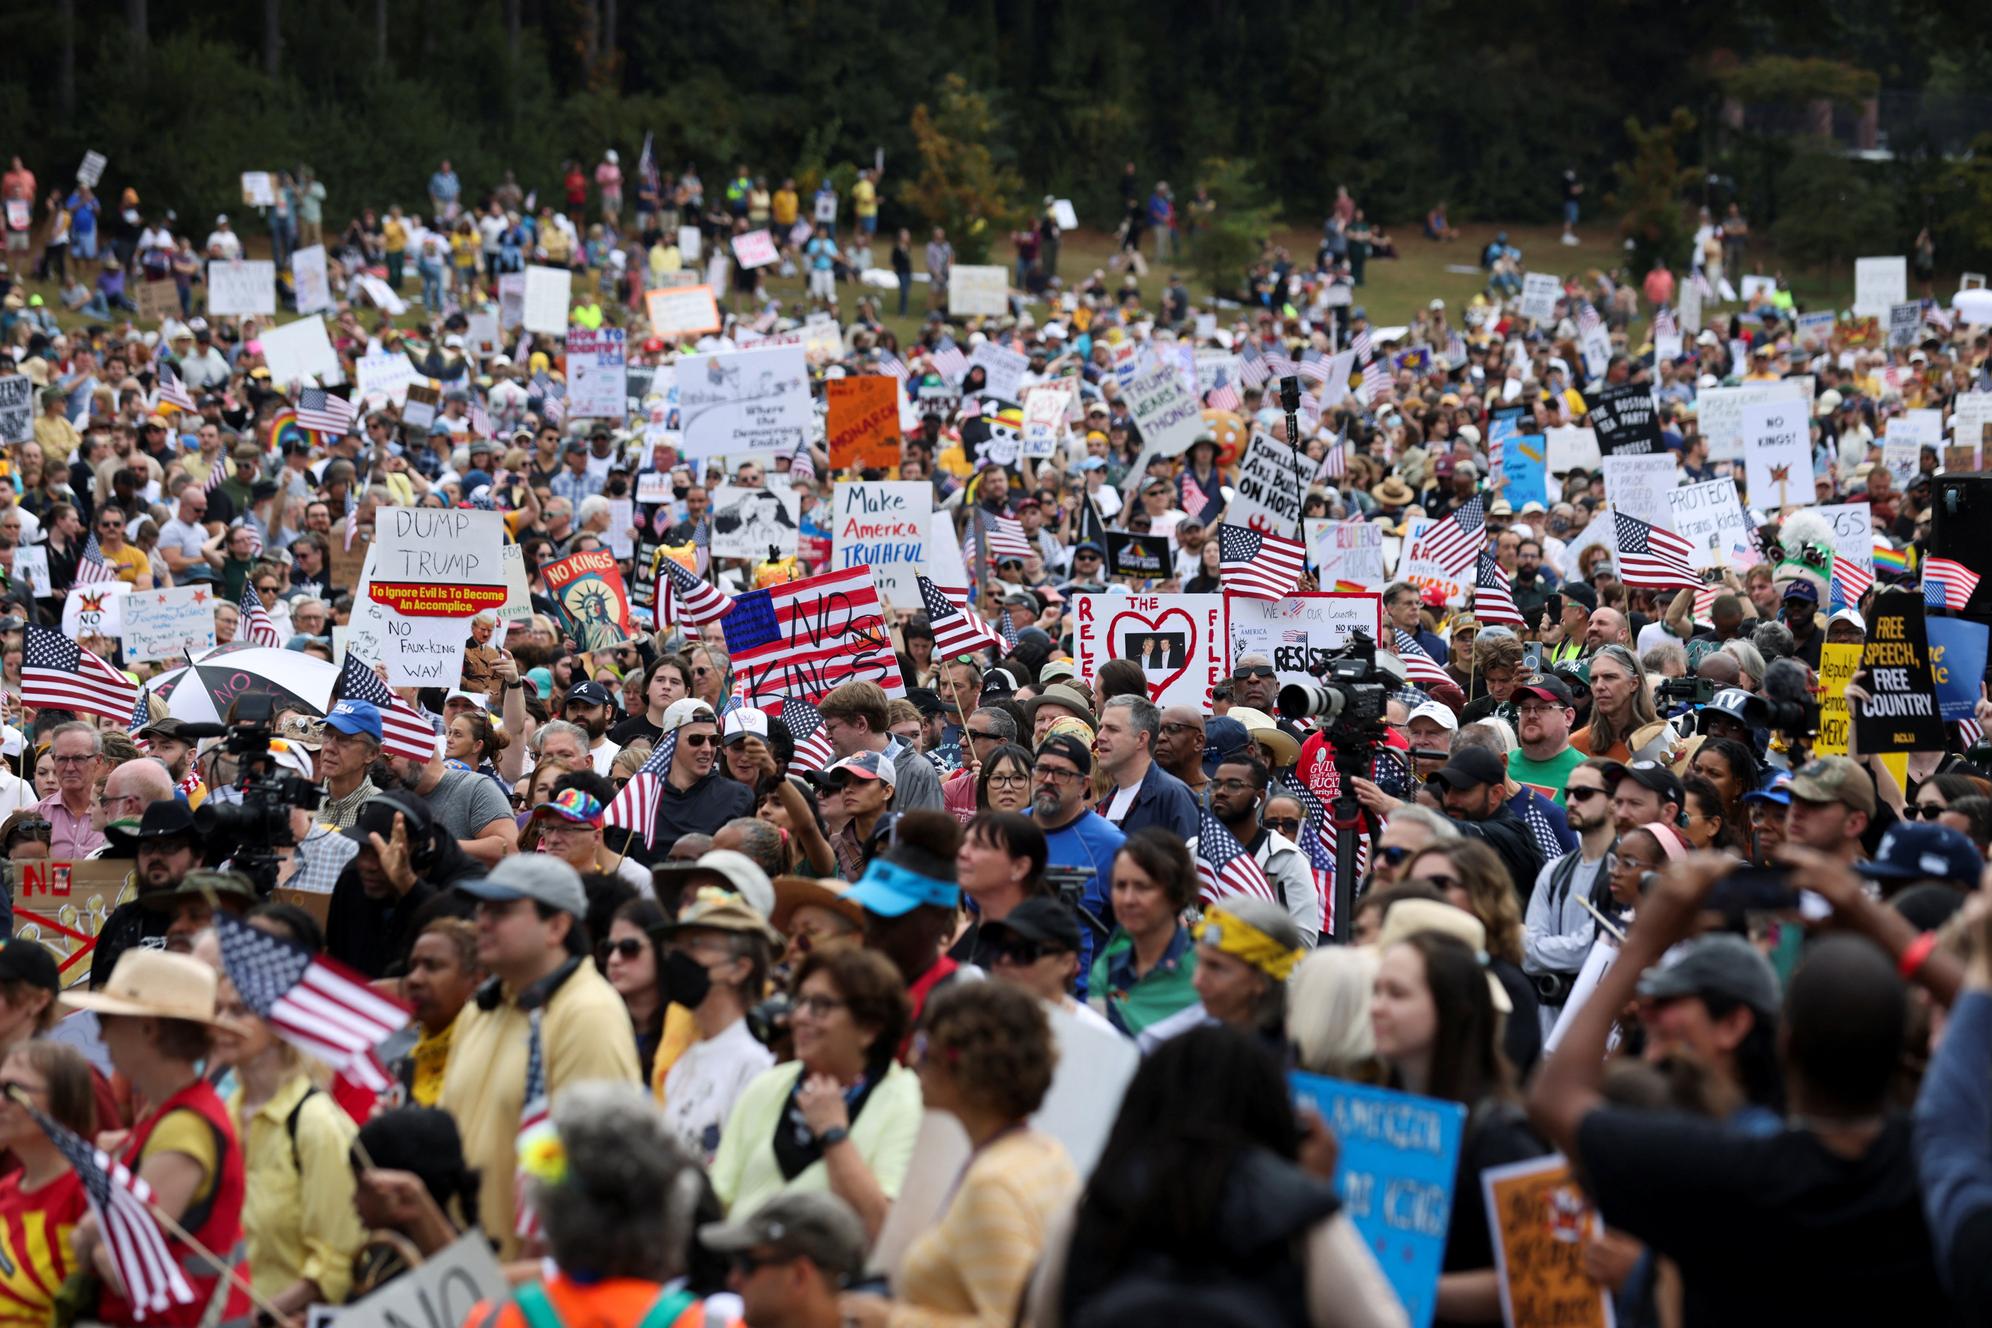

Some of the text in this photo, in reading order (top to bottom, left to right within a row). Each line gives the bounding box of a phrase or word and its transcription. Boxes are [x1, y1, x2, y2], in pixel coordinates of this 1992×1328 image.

[1124, 364, 1175, 399] TRUMP
[1133, 388, 1175, 418] WEARS
[830, 402, 898, 453] MONARCH
[1143, 400, 1198, 436] THONG
[1620, 411, 1650, 426] PARTY
[1766, 416, 1785, 427] NO
[1757, 433, 1797, 448] KINGS!
[846, 486, 906, 514] Make
[1239, 477, 1300, 522] ON HOPE
[1667, 479, 1737, 513] PROTECT
[396, 510, 471, 539] DUMP
[842, 517, 921, 539] America
[1337, 524, 1382, 549] QUEENS
[1677, 512, 1744, 538] trans kids
[398, 549, 480, 579] TRUMP
[841, 542, 926, 567] TRUTHFUL
[547, 552, 614, 586] NO KINGS
[127, 595, 146, 608] The
[371, 585, 505, 601] To Ignore Evil Is To Become
[1126, 596, 1159, 611] THE
[79, 613, 101, 625] NO
[400, 600, 476, 613] An Accomplice.
[1261, 602, 1278, 619] WE
[388, 620, 412, 636] NO
[790, 592, 852, 649] NO
[1335, 624, 1370, 633] NO KINGS!
[1876, 615, 1905, 640] FREE
[1864, 643, 1920, 669] SPEECH,
[403, 661, 443, 679] WAY!
[748, 651, 888, 709] KINGS
[1872, 667, 1911, 692] FREE
[214, 671, 252, 705] NO
[1716, 692, 1746, 710] TV
[1862, 694, 1934, 718] COUNTRY
[1816, 719, 1849, 747] AMERIC
[1893, 732, 1916, 745] ACLU
